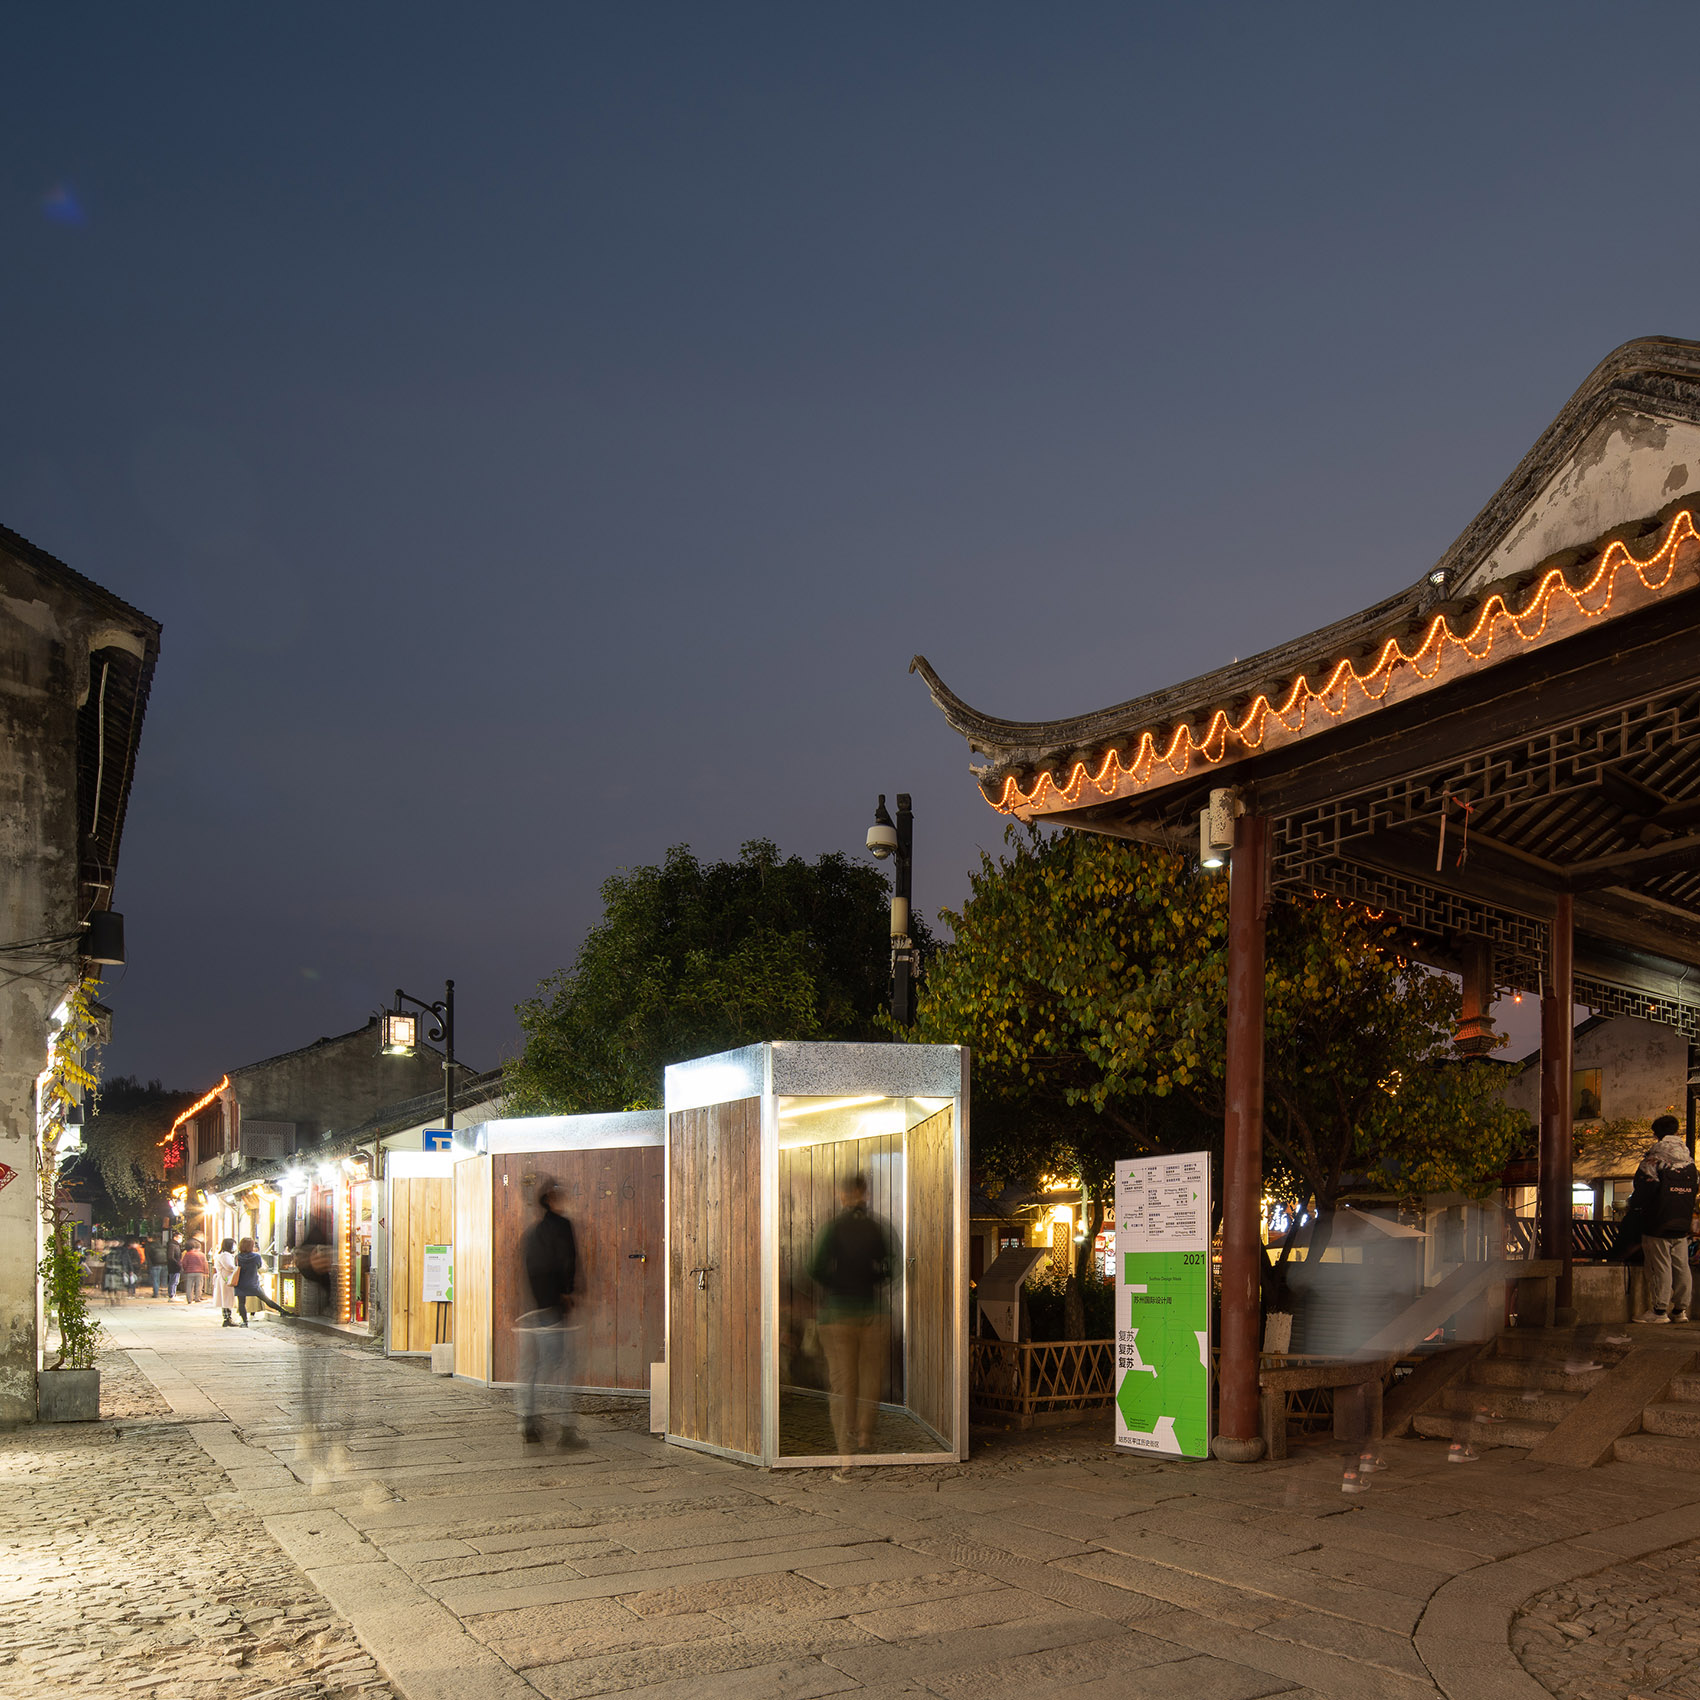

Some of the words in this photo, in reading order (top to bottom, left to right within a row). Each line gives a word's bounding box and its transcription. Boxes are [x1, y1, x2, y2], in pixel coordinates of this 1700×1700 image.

[622, 1175, 636, 1200] 6
[1183, 1254, 1205, 1265] 2021
[1133, 1296, 1172, 1305] 苏州国际设计周
[1118, 1330, 1134, 1342] 复苏
[1118, 1343, 1134, 1355] 复苏
[1118, 1357, 1134, 1369] 复苏
